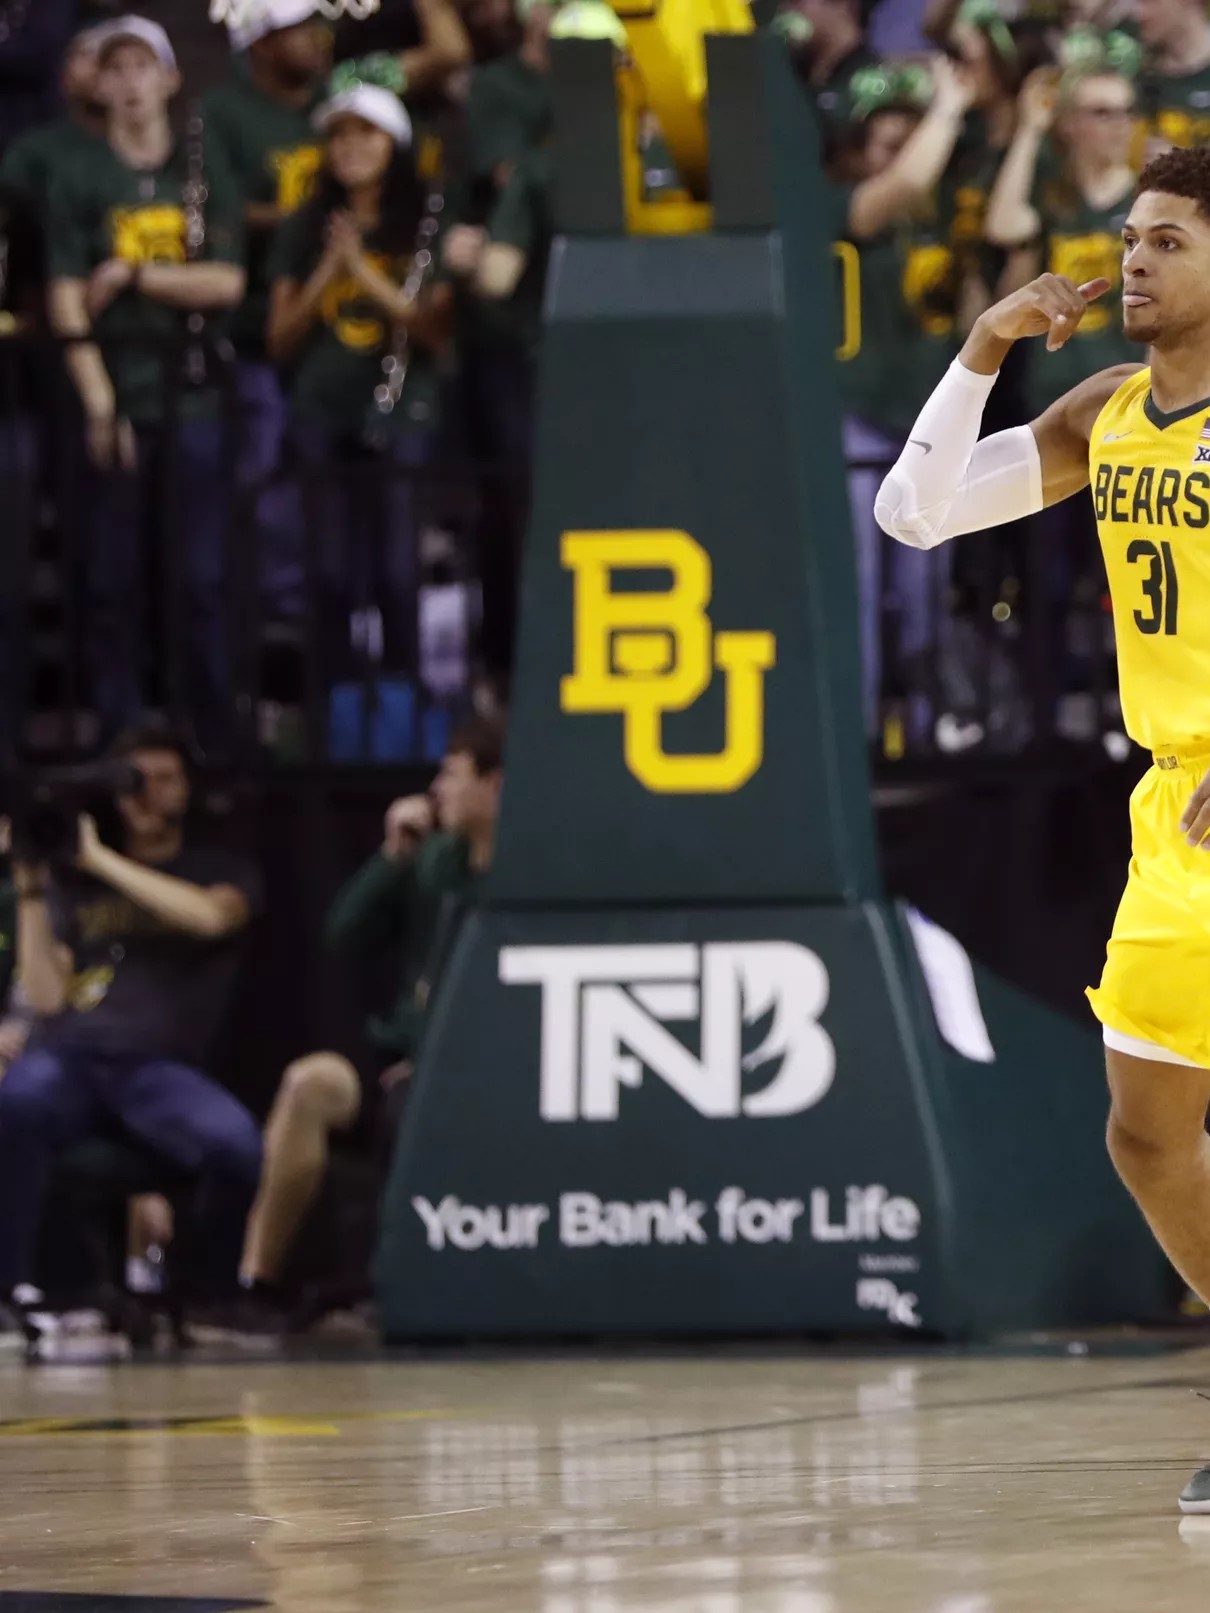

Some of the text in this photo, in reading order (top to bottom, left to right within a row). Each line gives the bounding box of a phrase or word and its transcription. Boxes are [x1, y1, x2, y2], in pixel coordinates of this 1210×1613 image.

[1095, 464, 1210, 528] BEARS
[1127, 540, 1178, 635] 31
[560, 529, 776, 794] BU
[413, 1184, 921, 1250] Your Bank for Life
